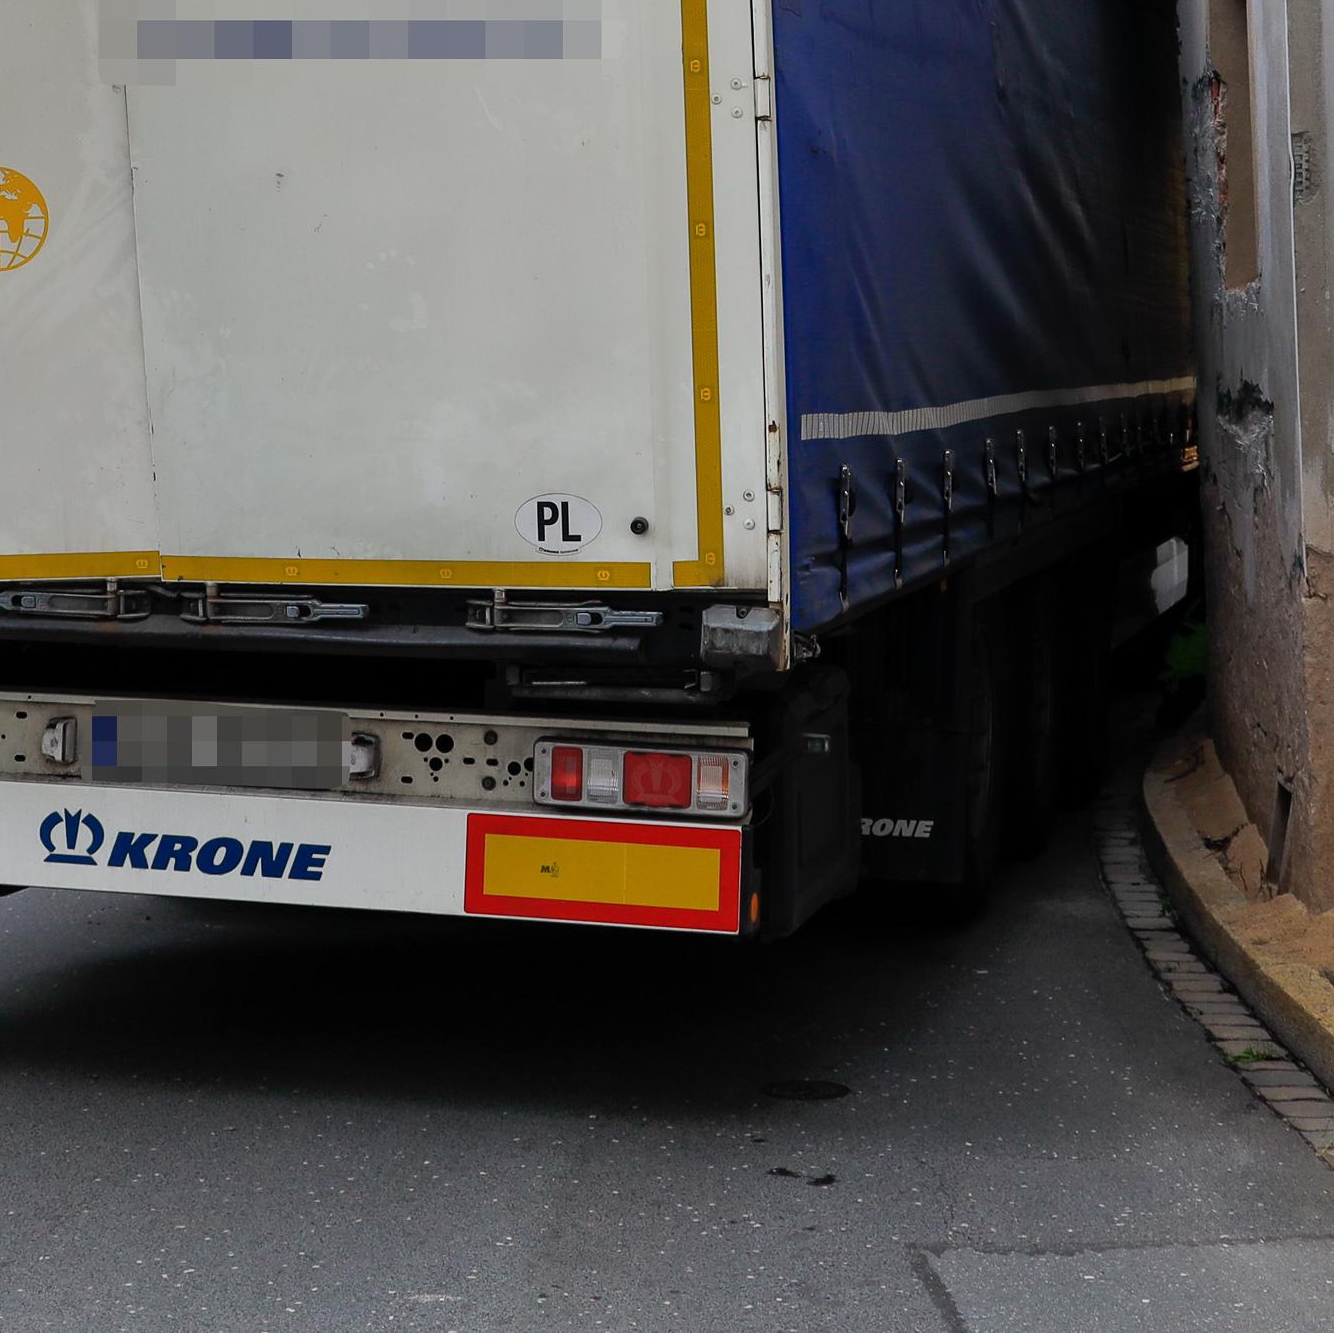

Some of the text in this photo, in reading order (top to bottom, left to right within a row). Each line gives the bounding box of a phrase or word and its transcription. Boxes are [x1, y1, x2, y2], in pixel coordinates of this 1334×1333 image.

[536, 501, 582, 542] PL
[861, 818, 935, 838] RONE
[107, 827, 332, 882] KRONE
